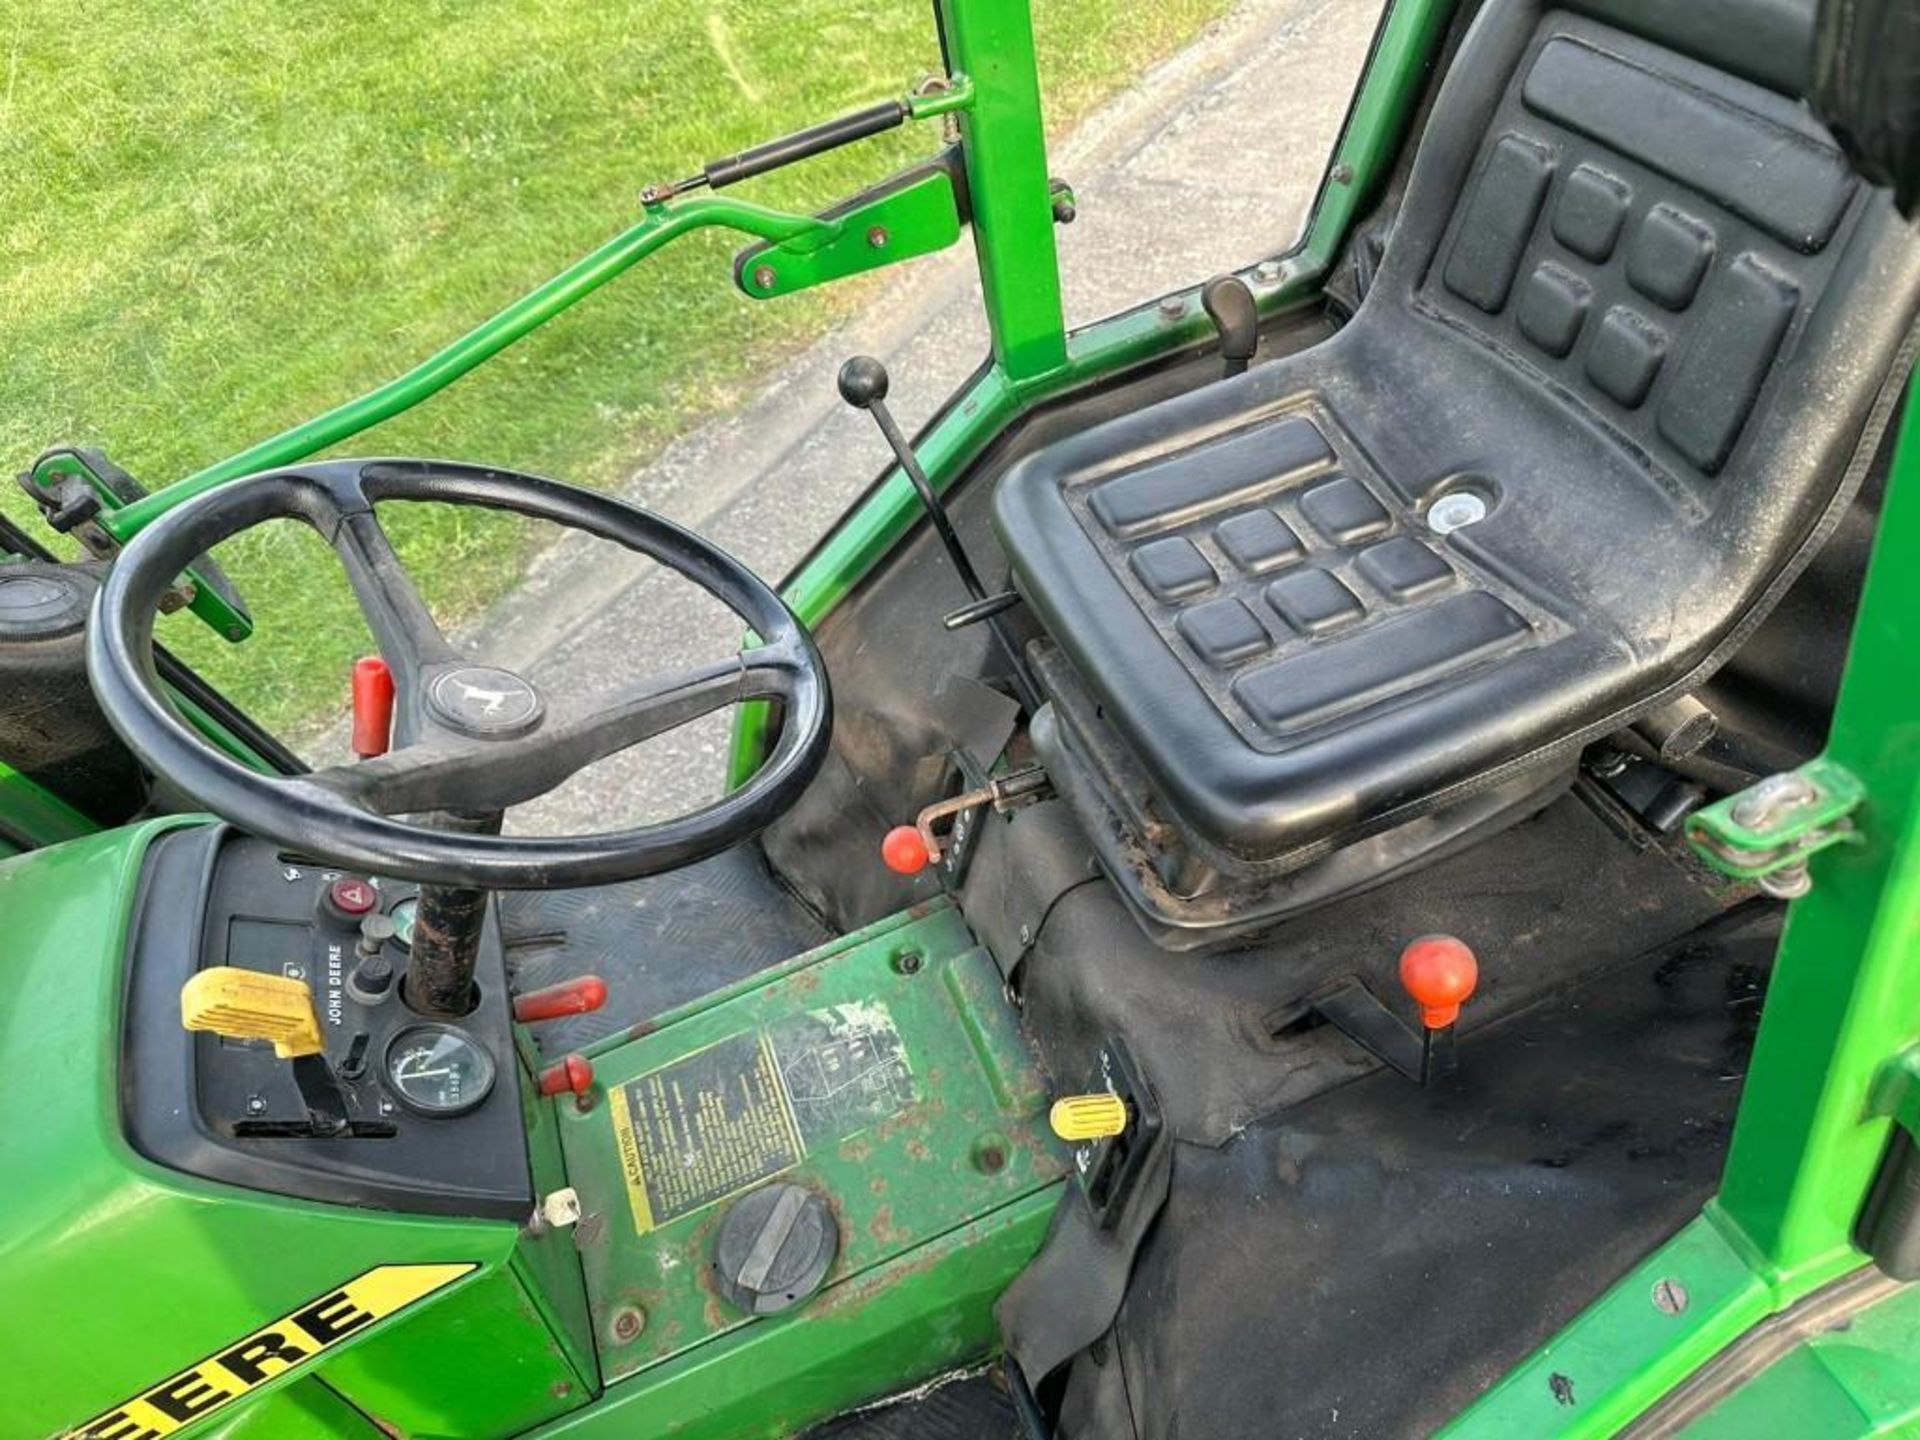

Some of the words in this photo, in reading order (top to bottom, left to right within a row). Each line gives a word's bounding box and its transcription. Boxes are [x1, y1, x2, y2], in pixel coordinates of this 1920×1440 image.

[328, 945, 342, 986] DEERE
[328, 989, 342, 1025] JOHN
[620, 1126, 639, 1175] CAUTION
